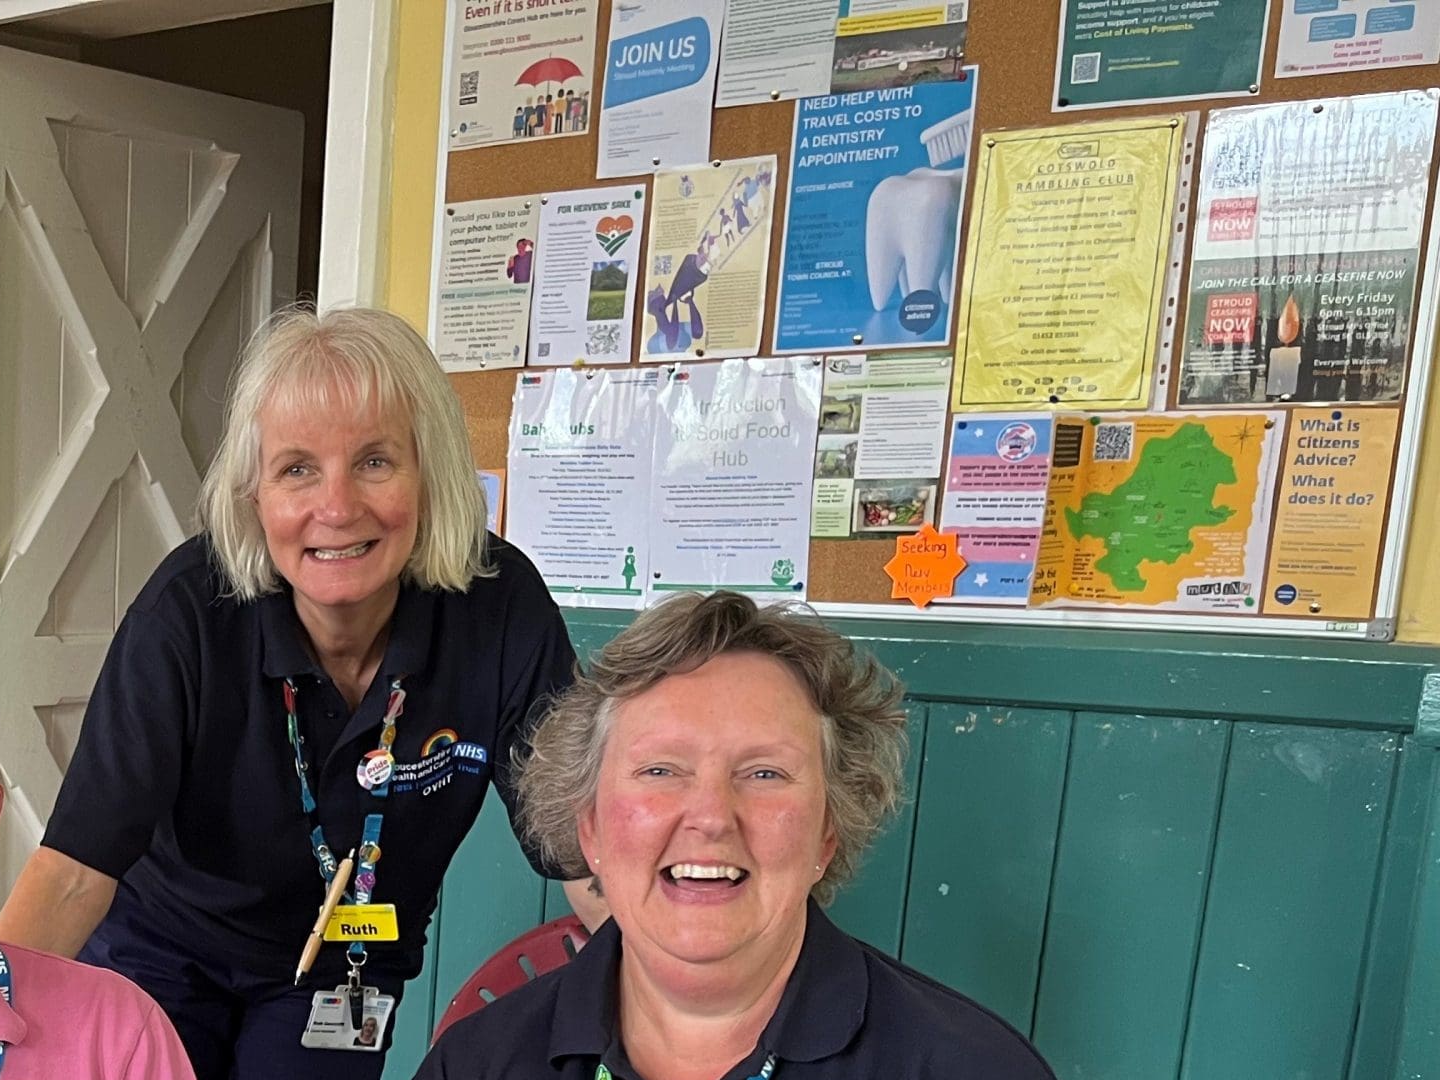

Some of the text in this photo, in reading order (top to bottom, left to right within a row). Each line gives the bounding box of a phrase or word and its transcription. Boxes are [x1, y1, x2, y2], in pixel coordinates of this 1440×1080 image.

[465, 6, 490, 20] Even
[493, 4, 501, 15] if
[504, 2, 511, 13] it
[514, 1, 523, 11] is
[1078, 0, 1109, 10] Support
[1126, 6, 1141, 15] with
[1143, 5, 1167, 15] paying
[1169, 3, 1180, 11] for
[527, 14, 538, 22] Hub
[1075, 22, 1105, 30] income
[1093, 29, 1113, 38] Cost
[1114, 27, 1124, 36] of
[1124, 25, 1149, 36] Living
[615, 36, 696, 67] JOIN US
[667, 63, 695, 73] Meeting
[804, 86, 914, 112] NEED HELP WITH
[803, 104, 922, 130] TRAVEL COSTS TO
[800, 128, 886, 149] A DENTISTRY
[798, 146, 899, 168] APPOINTMENT?
[1037, 159, 1117, 174] COTSWOLD
[1016, 174, 1134, 192] RAMBLING CLUB
[557, 205, 572, 214] FOR
[611, 200, 631, 209] SAKE
[1067, 196, 1084, 206] good
[476, 212, 490, 222] you
[492, 211, 505, 219] like
[450, 227, 466, 236] your
[495, 221, 518, 230] tablet
[1212, 218, 1252, 233] NOW
[449, 236, 486, 246] computer
[1197, 268, 1406, 290] JOIN THE CALL FOR A CEASEFIRE NOW
[1212, 297, 1252, 308] STROUD
[1320, 292, 1395, 307] Every Friday
[904, 303, 934, 312] citizens
[1319, 306, 1395, 319] 6pm 6.15pm
[906, 312, 931, 320] advice
[1210, 317, 1251, 332] NOW
[1313, 356, 1388, 368] Everyone Welcome
[697, 421, 791, 441] Solid Food
[1300, 419, 1360, 432] What is
[1297, 436, 1360, 449] Citizens
[713, 450, 749, 467] Hub
[1294, 454, 1357, 466] Advice?
[1292, 475, 1335, 487] What
[1288, 492, 1374, 506] does it do?
[901, 541, 948, 560] Seeking
[905, 564, 930, 578] New
[897, 581, 950, 593] Members
[394, 744, 485, 772] oucestershire NHS
[367, 760, 388, 775] Pride
[392, 771, 417, 782] ealth
[417, 766, 433, 778] and
[422, 772, 454, 797] OVHT
[341, 923, 378, 936] Ruth
